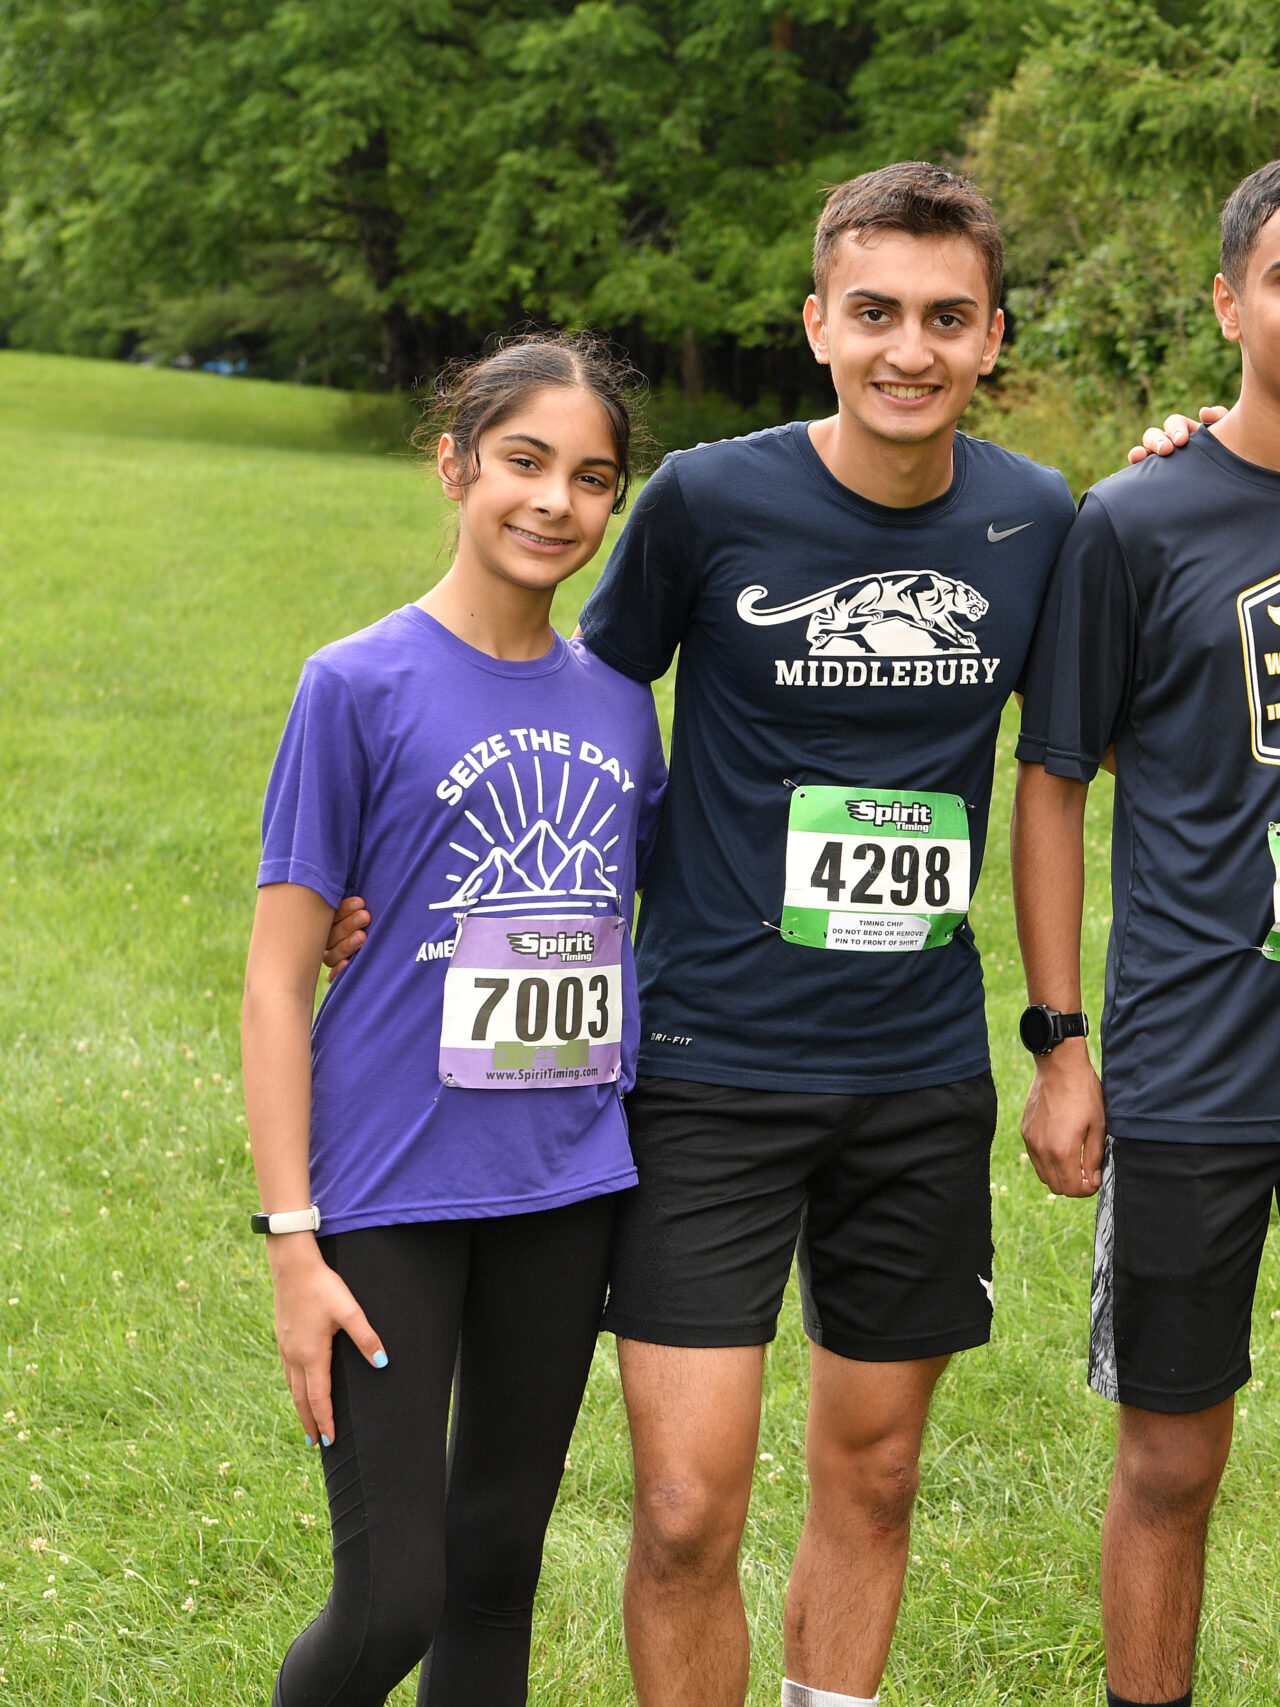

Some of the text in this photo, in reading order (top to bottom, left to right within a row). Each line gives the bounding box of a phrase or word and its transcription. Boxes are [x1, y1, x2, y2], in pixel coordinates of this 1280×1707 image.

[774, 658, 1001, 688] MIDDLEBURY
[436, 728, 635, 807] SEIZE THE DAY
[848, 800, 932, 826] Spirit
[895, 821, 930, 833] Timing
[810, 841, 951, 907] 4298
[859, 919, 885, 927] TIMING
[415, 939, 455, 962] AME
[510, 932, 594, 956] Spirit
[560, 951, 593, 963] Timing
[471, 974, 609, 1043] 7003
[486, 1066, 599, 1083] www.SpiritTiming.com
